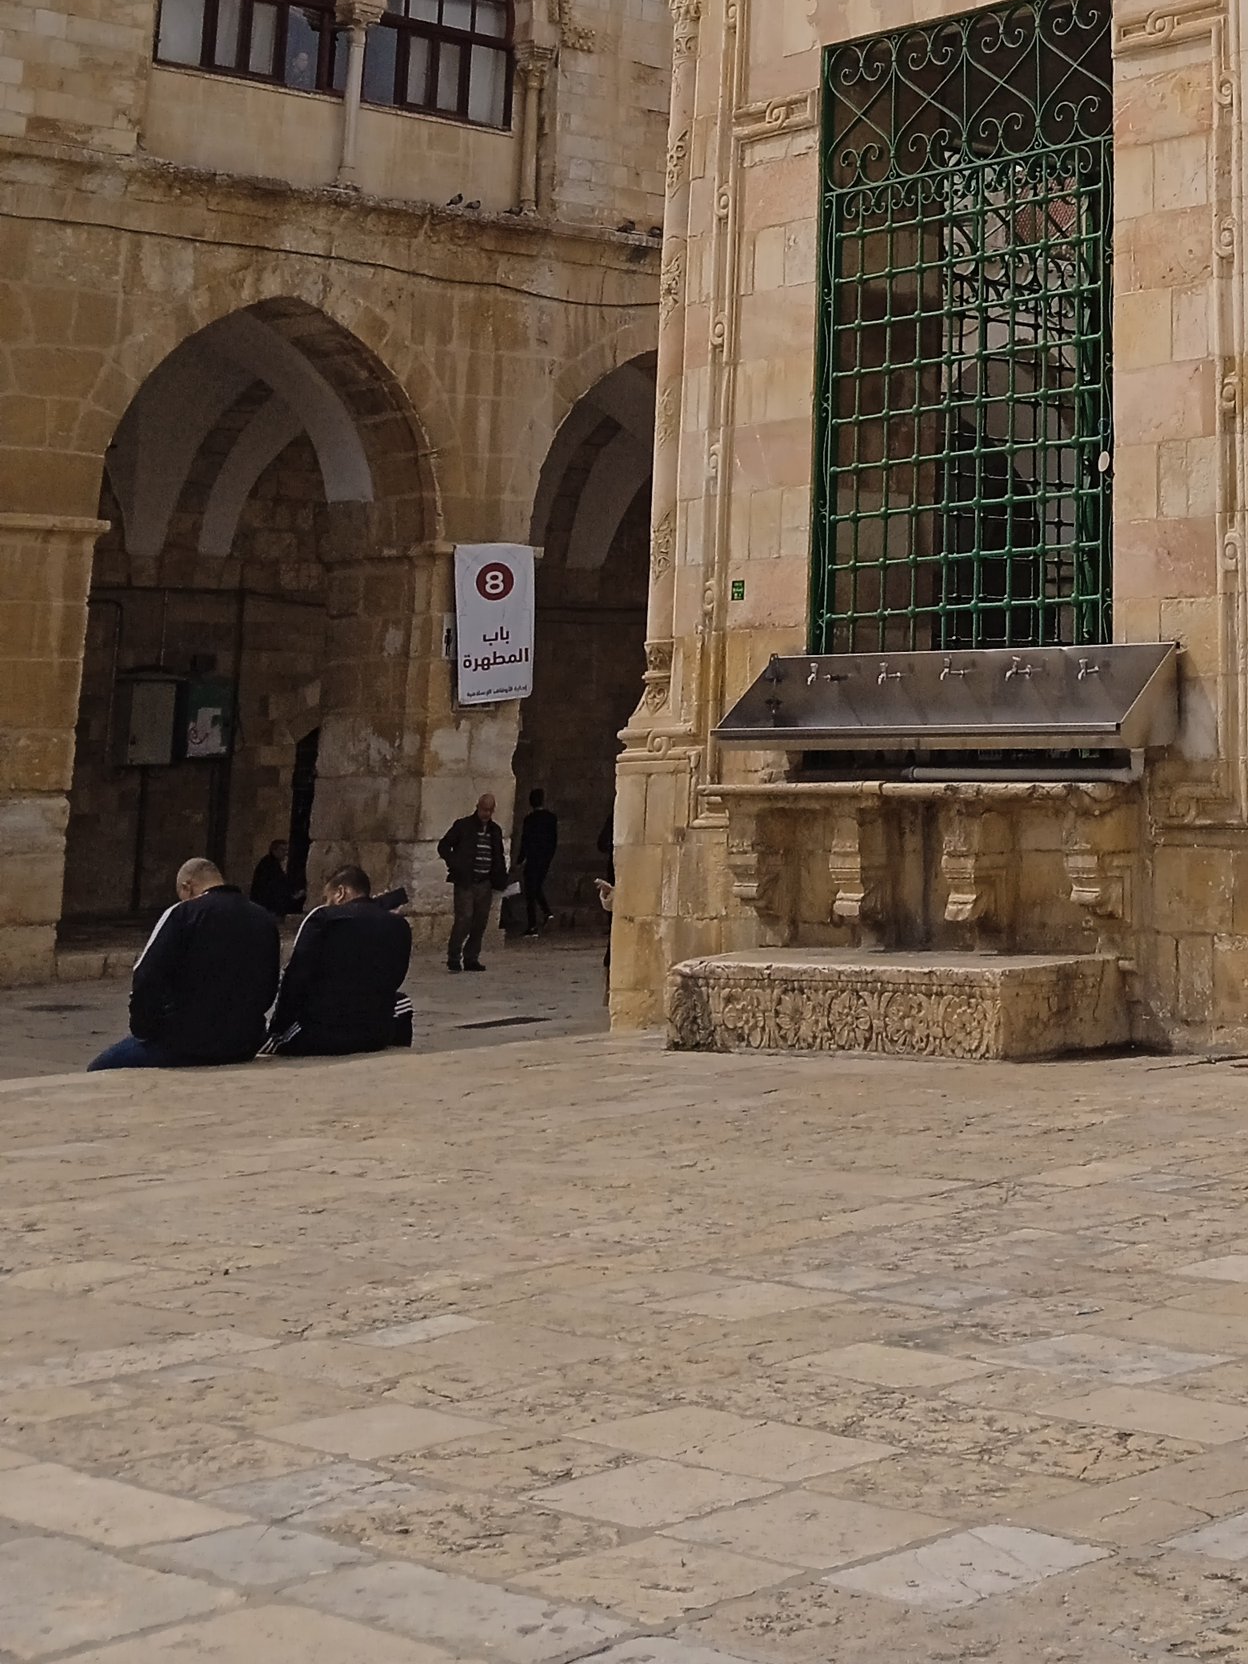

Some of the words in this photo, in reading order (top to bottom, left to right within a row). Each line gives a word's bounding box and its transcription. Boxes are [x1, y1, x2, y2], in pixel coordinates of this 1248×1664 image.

[484, 571, 504, 594] 8
[483, 626, 510, 646] باب
[463, 648, 529, 672] المطهرة
